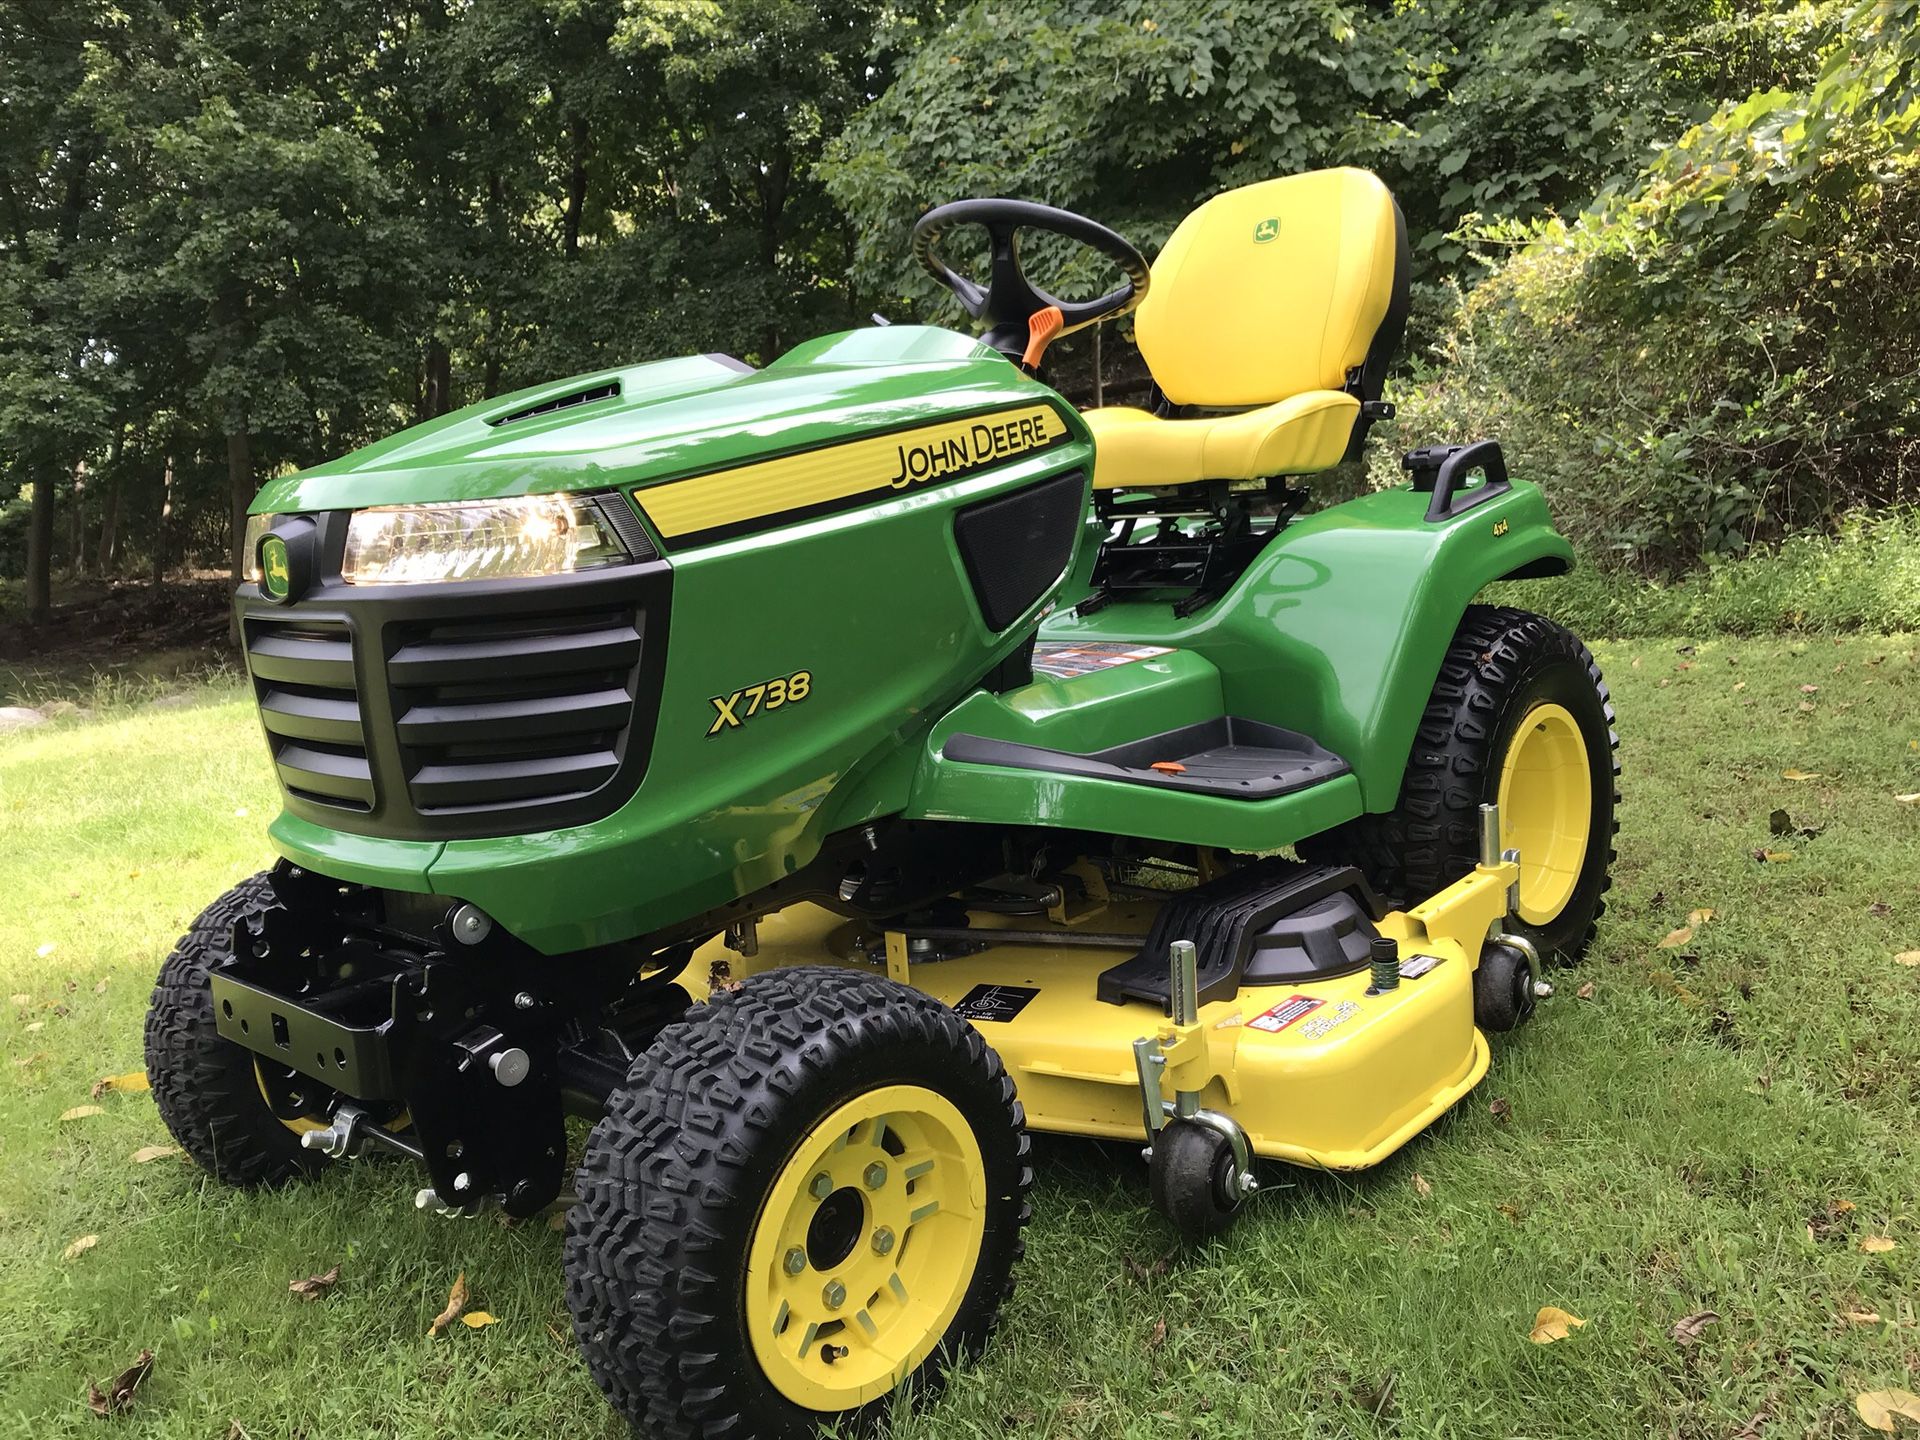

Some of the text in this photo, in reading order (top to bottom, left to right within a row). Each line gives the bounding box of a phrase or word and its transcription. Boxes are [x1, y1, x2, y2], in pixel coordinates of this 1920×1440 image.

[891, 414, 1047, 485] JOHN DEERE
[705, 670, 812, 736] X738
[1305, 1005, 1363, 1040] CAPACITY
